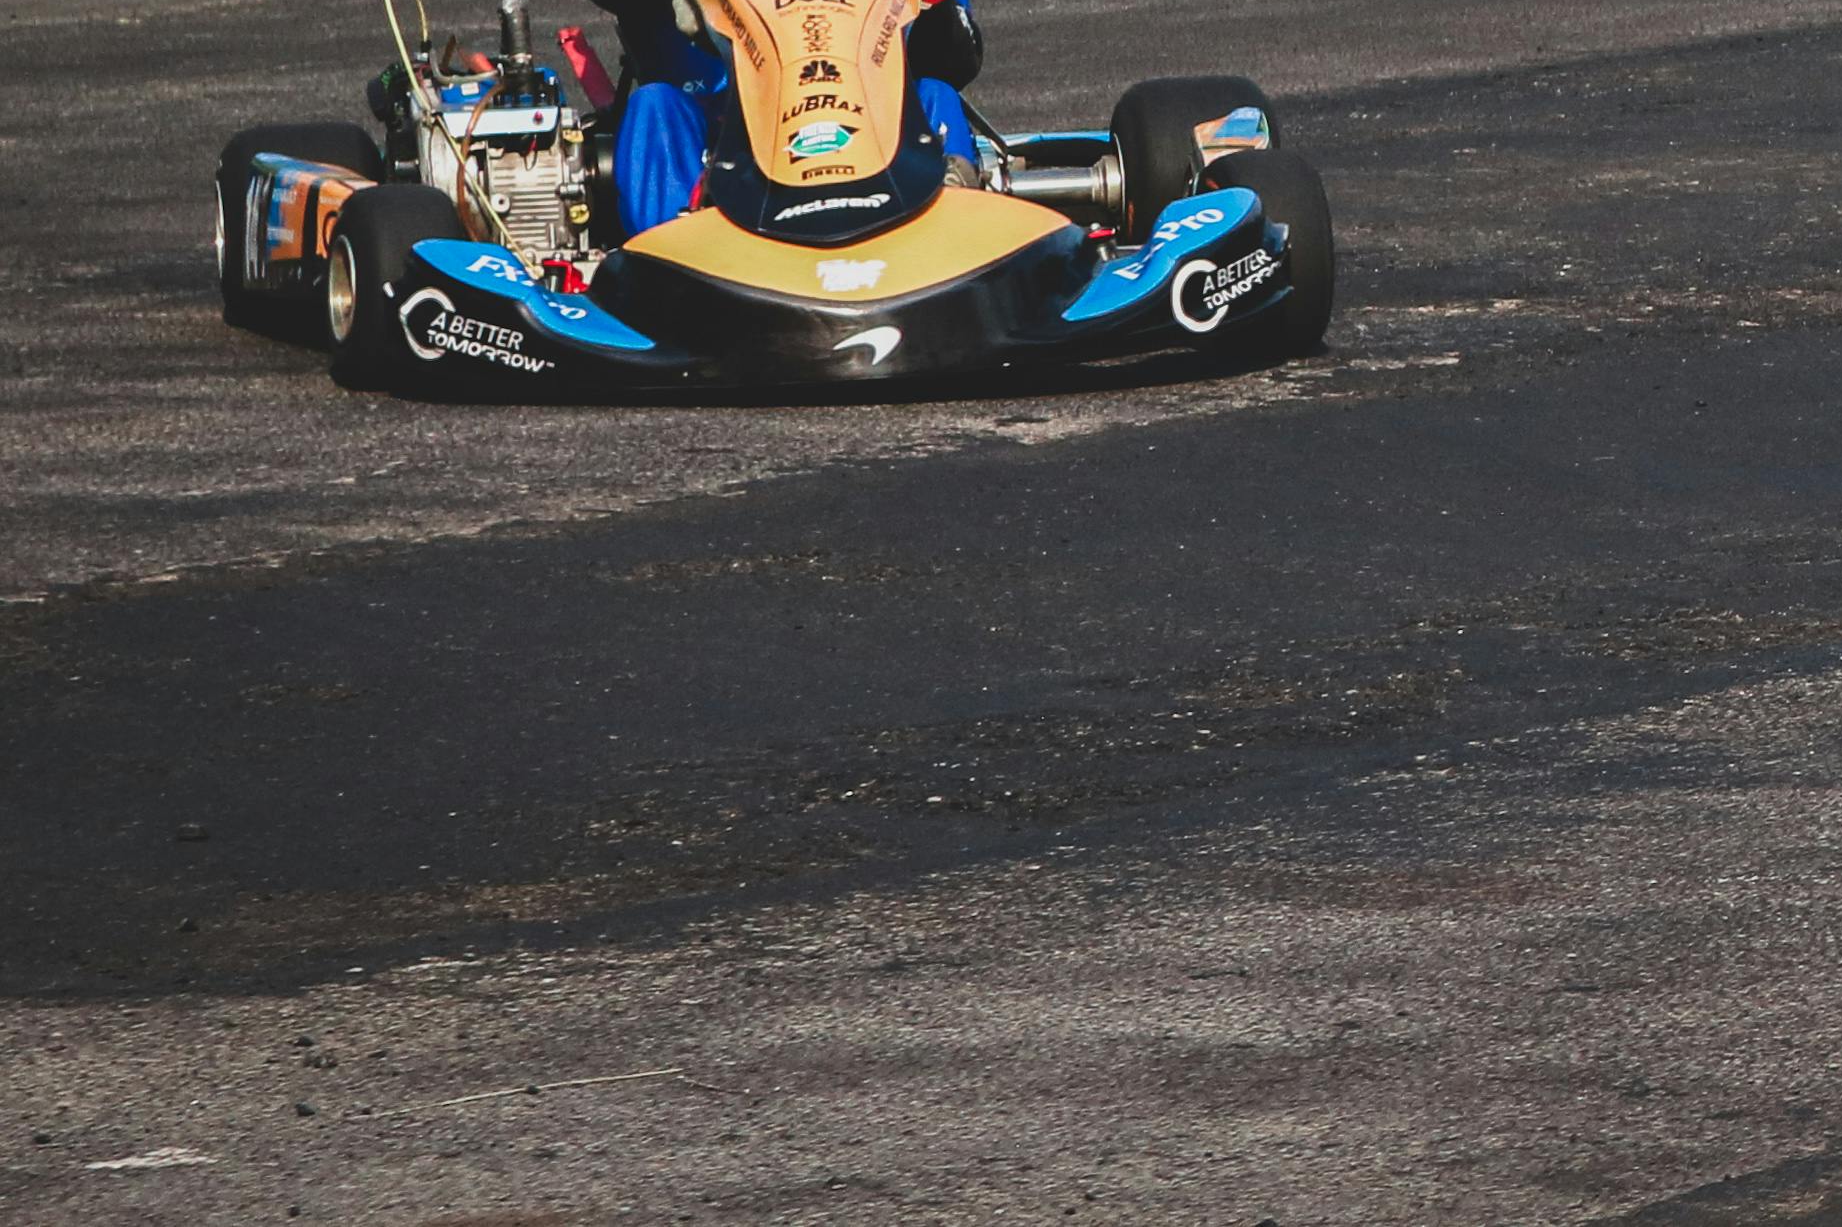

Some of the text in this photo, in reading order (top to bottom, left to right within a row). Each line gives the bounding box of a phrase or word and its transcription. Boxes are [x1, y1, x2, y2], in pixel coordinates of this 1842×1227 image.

[782, 93, 865, 124] LUBRAX
[1112, 208, 1224, 280] FPro
[1203, 248, 1272, 295] A BETTER
[430, 311, 524, 351] A BETTER
